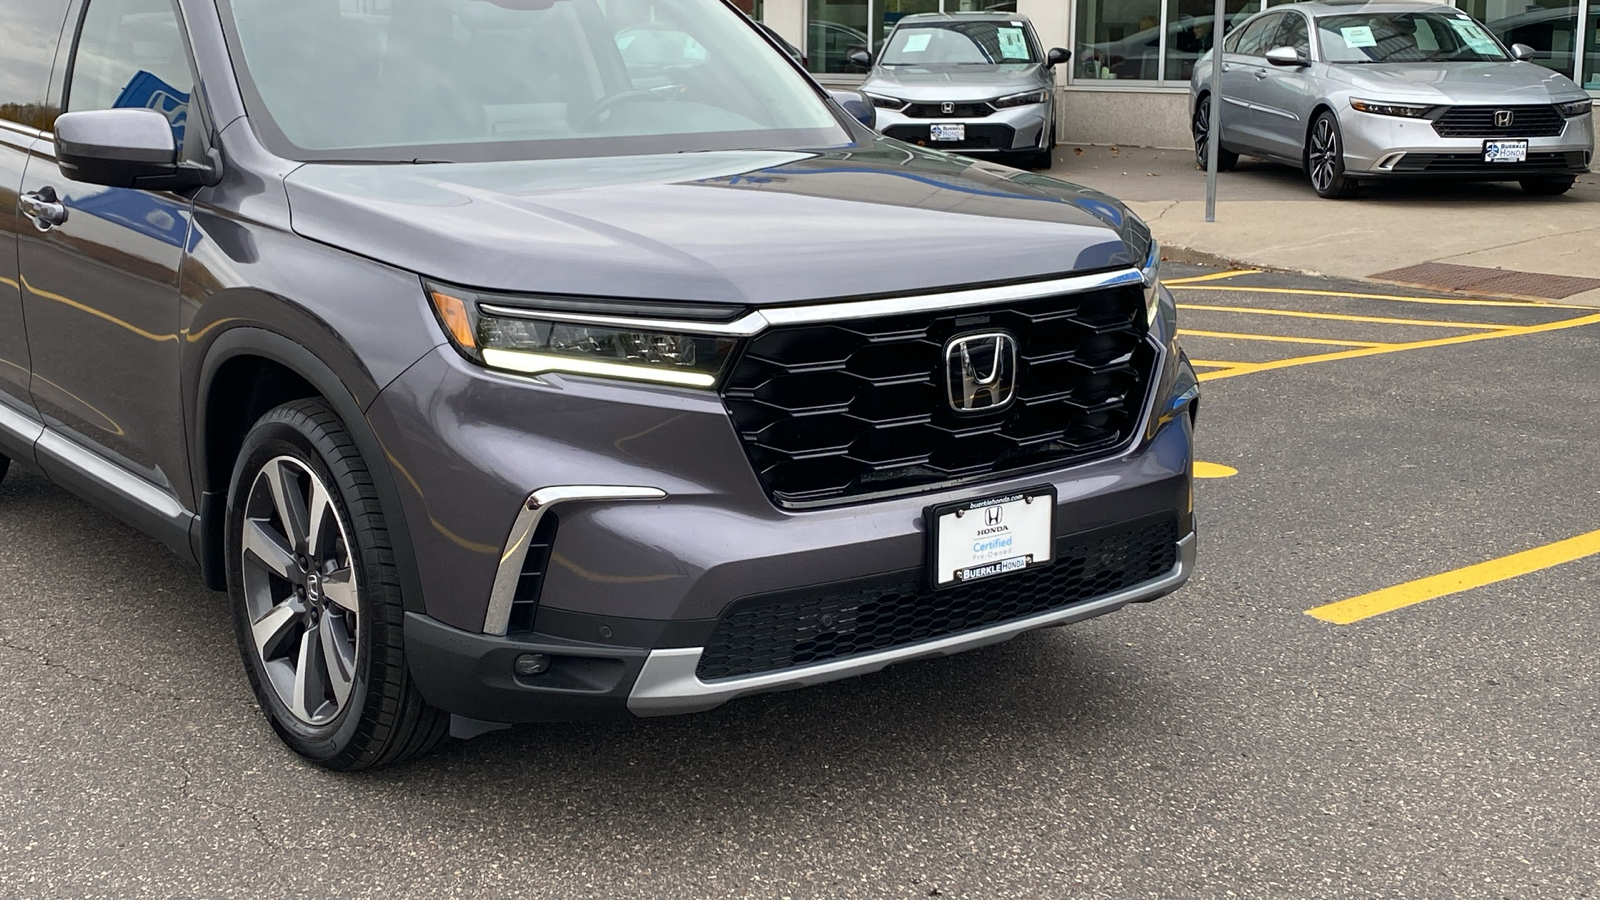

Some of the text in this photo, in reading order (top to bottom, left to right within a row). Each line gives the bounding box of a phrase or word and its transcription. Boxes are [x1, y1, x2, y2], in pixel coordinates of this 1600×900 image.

[1500, 149, 1525, 157] HONDA
[970, 494, 1024, 509] buerklehonda.com
[976, 525, 1009, 536] HONDA
[973, 535, 1013, 553] Certified
[972, 547, 1013, 561] Pre-Owned
[963, 558, 1025, 580] BUERKLE HONDA
